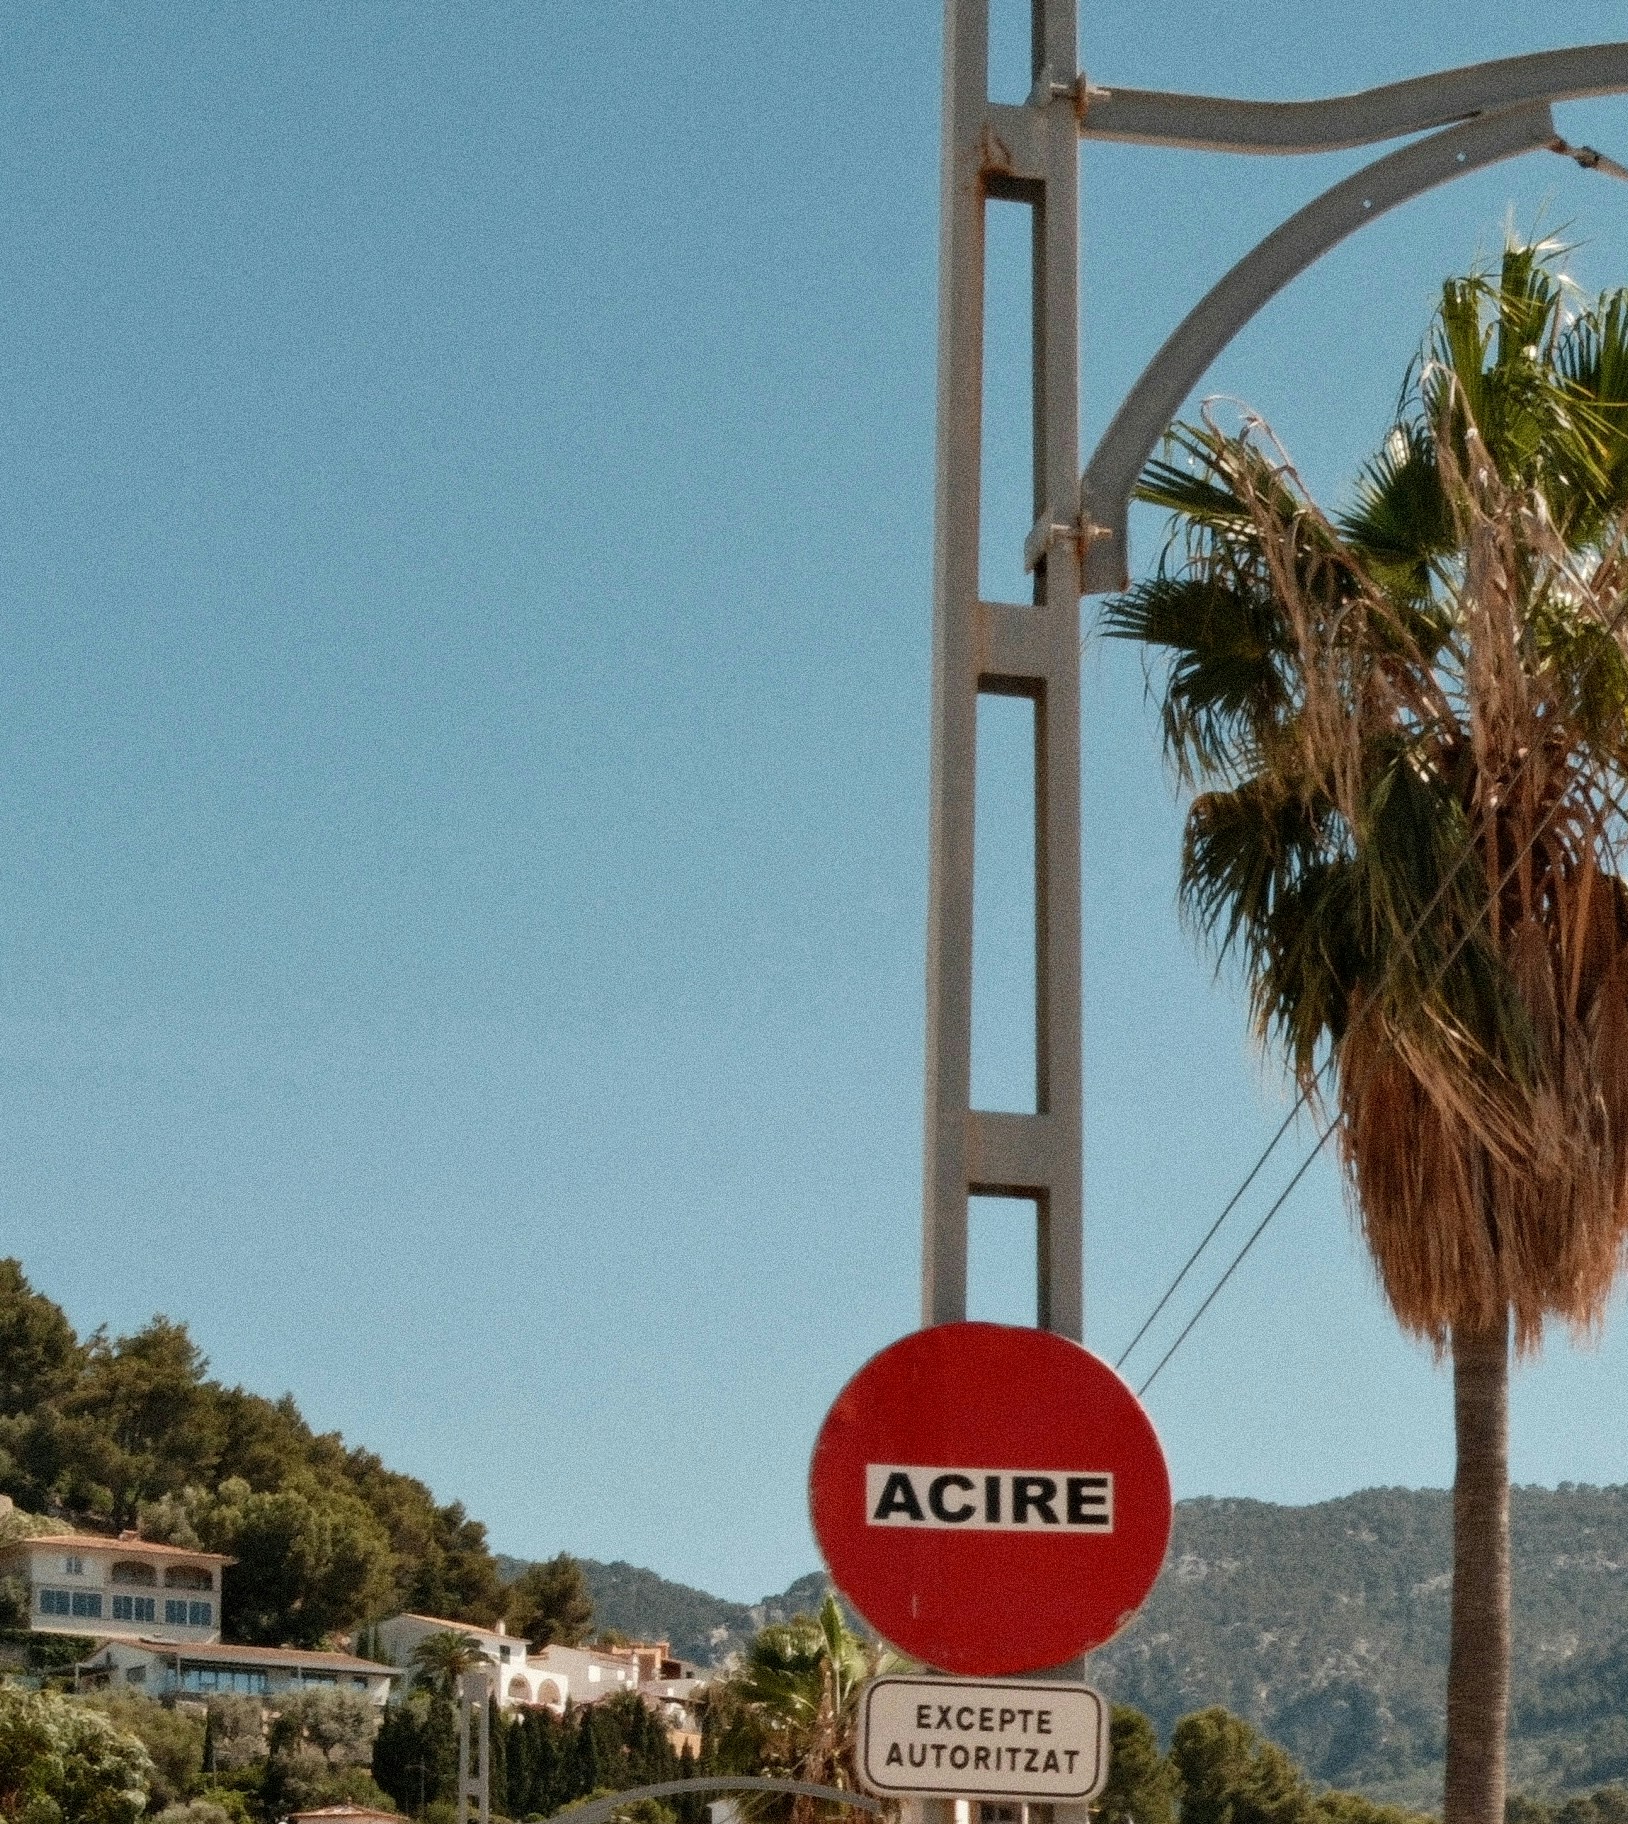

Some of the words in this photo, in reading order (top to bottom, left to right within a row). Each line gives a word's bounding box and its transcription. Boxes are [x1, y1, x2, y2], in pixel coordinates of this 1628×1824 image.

[873, 1472, 1109, 1525] ACIRE
[916, 1705, 1052, 1734] EXCEPTE
[885, 1742, 1080, 1774] AUTORITZAT
